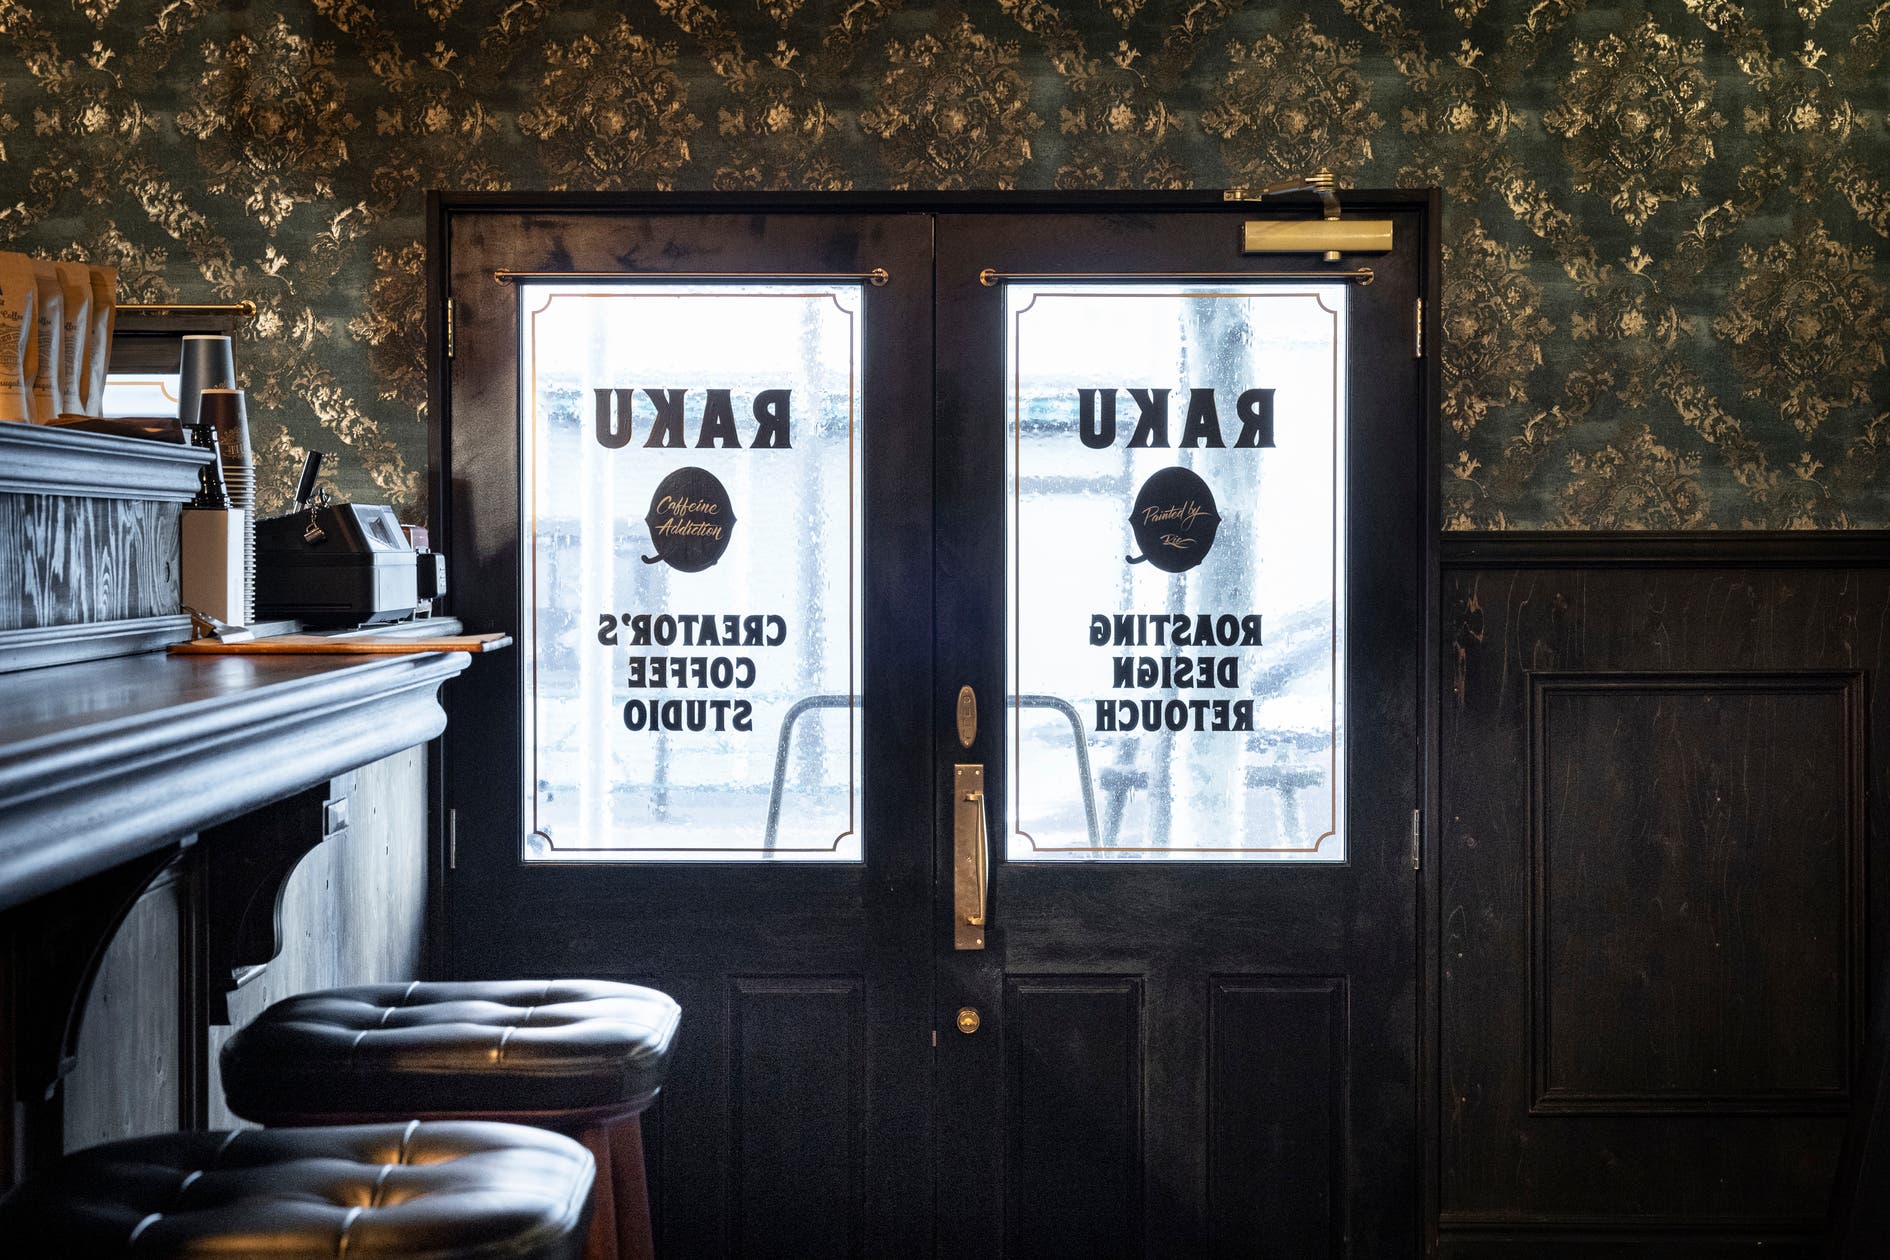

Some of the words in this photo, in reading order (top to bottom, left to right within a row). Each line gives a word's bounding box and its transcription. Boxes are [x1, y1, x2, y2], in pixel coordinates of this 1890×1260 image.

[656, 495, 720, 516] Caffeine
[1141, 500, 1188, 526] Painted
[1180, 499, 1213, 533] by
[655, 517, 724, 541] Addiction
